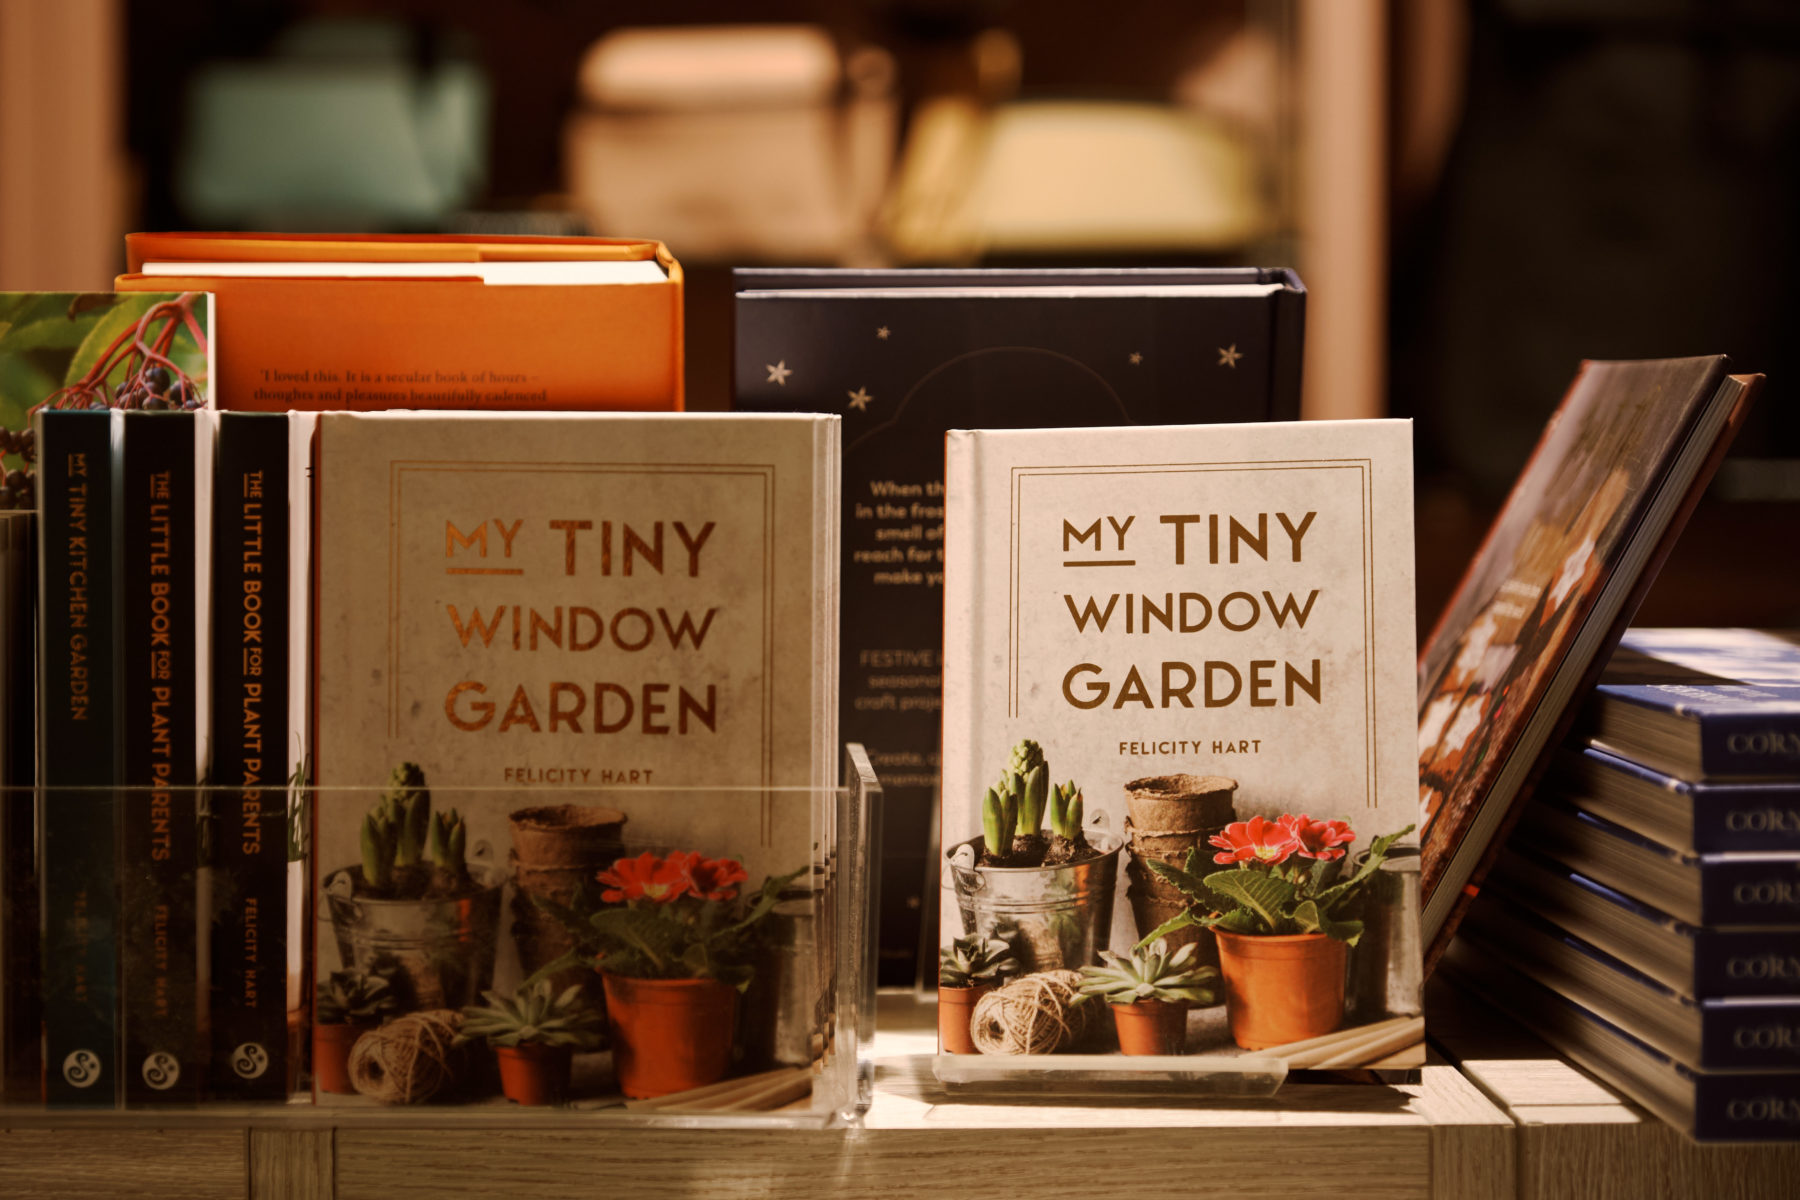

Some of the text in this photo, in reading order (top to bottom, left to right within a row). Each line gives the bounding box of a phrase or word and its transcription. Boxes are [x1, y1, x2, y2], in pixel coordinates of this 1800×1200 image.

[254, 388, 547, 404] thoughts and pleasures beautifully cadenced
[273, 369, 310, 383] loved
[345, 370, 357, 383] It
[360, 370, 371, 383] is
[374, 374, 382, 383] a
[385, 370, 433, 384] secular
[434, 370, 468, 384] book
[471, 370, 486, 384] of
[488, 370, 527, 384] hours
[855, 503, 873, 519] in
[877, 503, 908, 519] the
[871, 481, 923, 497] When
[446, 518, 717, 577] MY TINY
[853, 547, 904, 563] reach
[907, 547, 935, 563] for
[875, 525, 923, 541] smell
[1063, 511, 1317, 565] MY TINY
[69, 453, 88, 720] MY TINY KITCHEN GARDEN
[873, 568, 924, 585] make
[446, 604, 721, 651] WINDOW
[1063, 589, 1320, 634] WINDOW
[151, 471, 171, 861] THE LITTLE BOOK FOR PLANT PARENTS
[242, 470, 263, 855] THE LITTLE BOOK FOR PLANT PARENTS
[860, 650, 933, 668] FESTIVE
[1062, 659, 1321, 710] GARDEN
[444, 681, 717, 735] GARDEN
[1119, 740, 1261, 755] FELICITY HART
[504, 767, 653, 784] FELICITY HART
[154, 905, 168, 1017] FELICITY HART
[245, 898, 258, 1008] FELICITY HART
